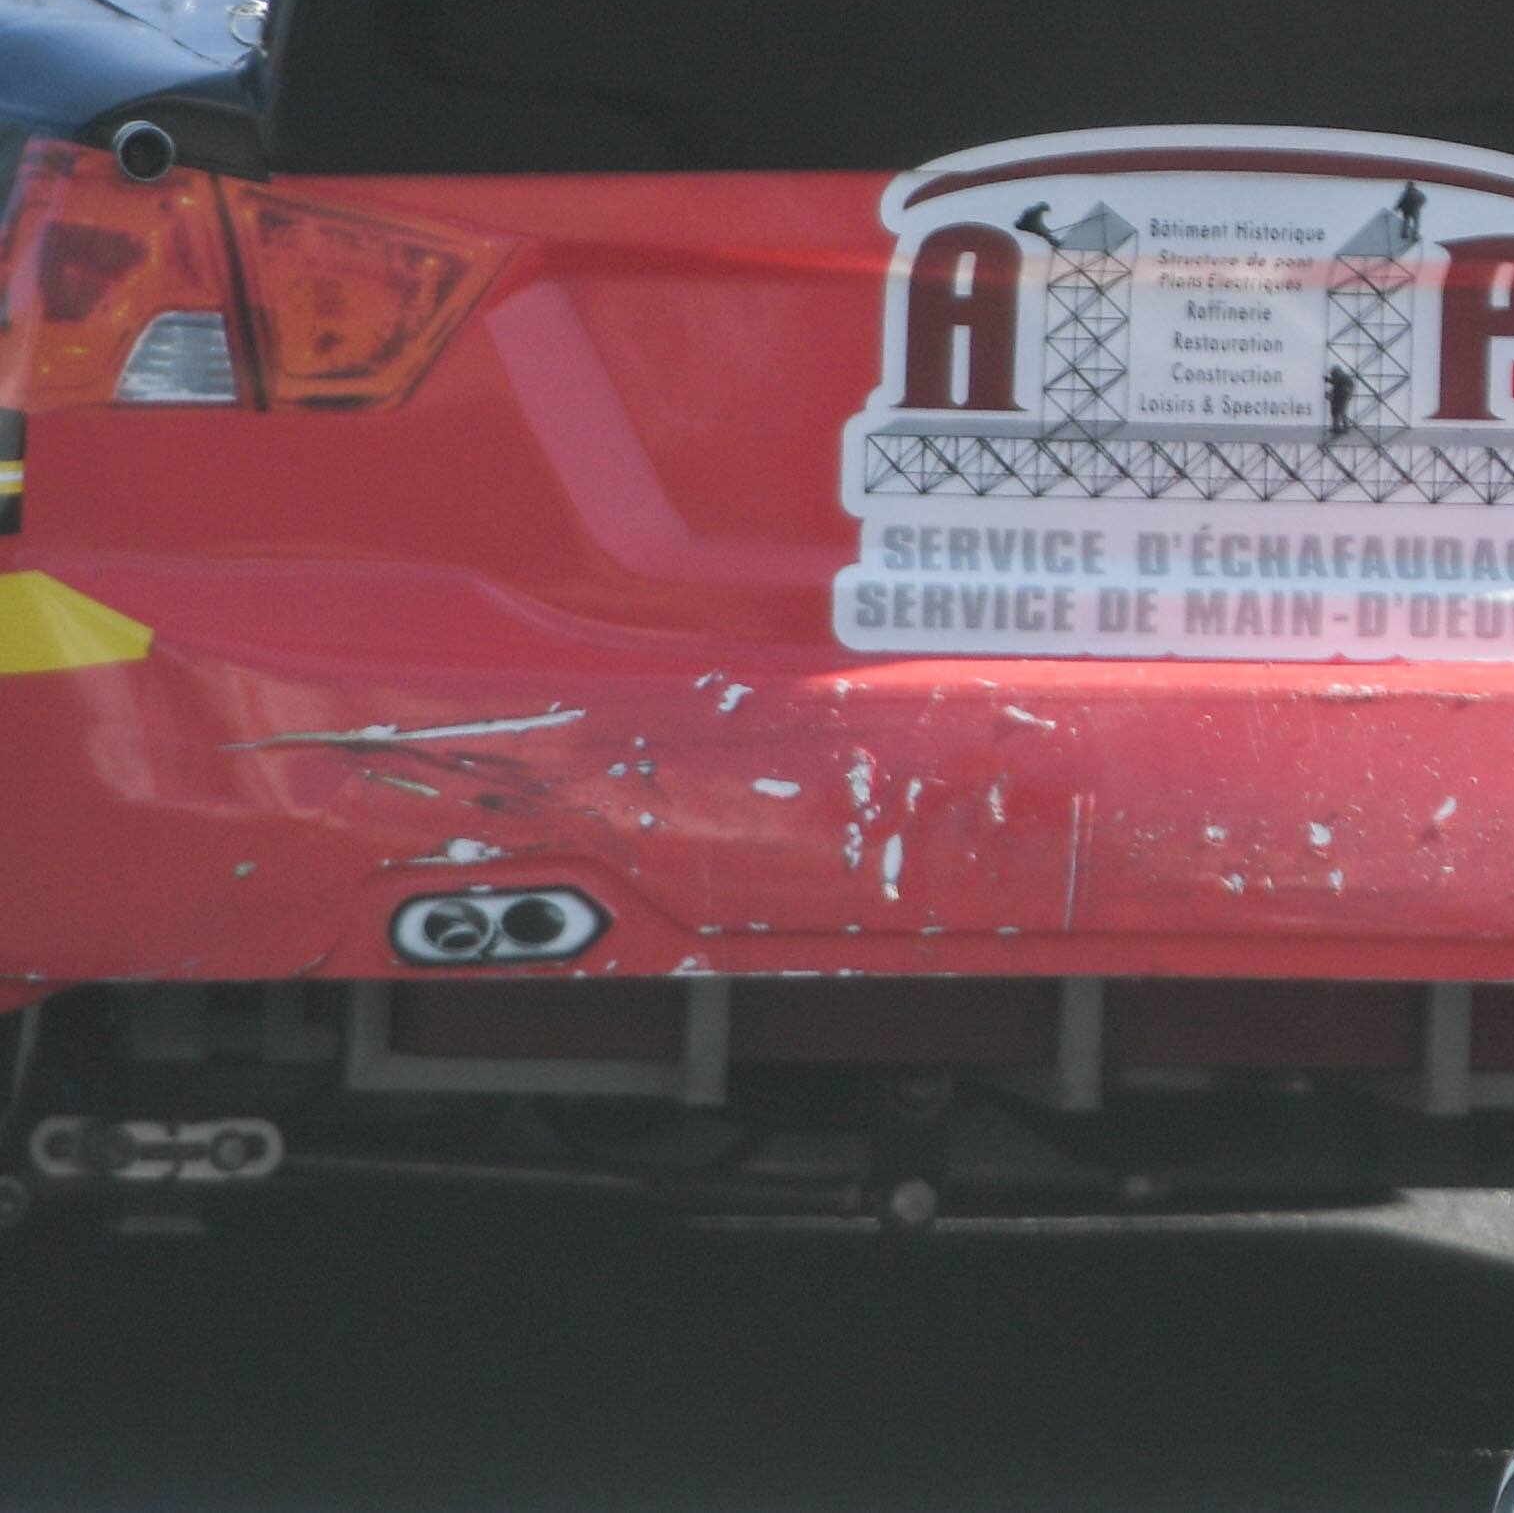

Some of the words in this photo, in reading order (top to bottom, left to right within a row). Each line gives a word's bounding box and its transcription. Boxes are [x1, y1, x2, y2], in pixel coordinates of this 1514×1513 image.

[1151, 218, 1228, 238] Bâtiment
[1236, 221, 1326, 244] Historique
[1158, 249, 1239, 266] Structure
[1247, 251, 1266, 267] de
[1186, 299, 1272, 321] Raffinerie
[1173, 331, 1283, 353] Restauration
[1171, 362, 1283, 384] Construction
[1139, 393, 1195, 413] Loisirs
[1202, 394, 1213, 414] &
[1222, 394, 1313, 418] Spectacles
[882, 525, 1105, 575] SERVICE
[855, 581, 1075, 632] SERVICE
[1097, 586, 1158, 634] DE
